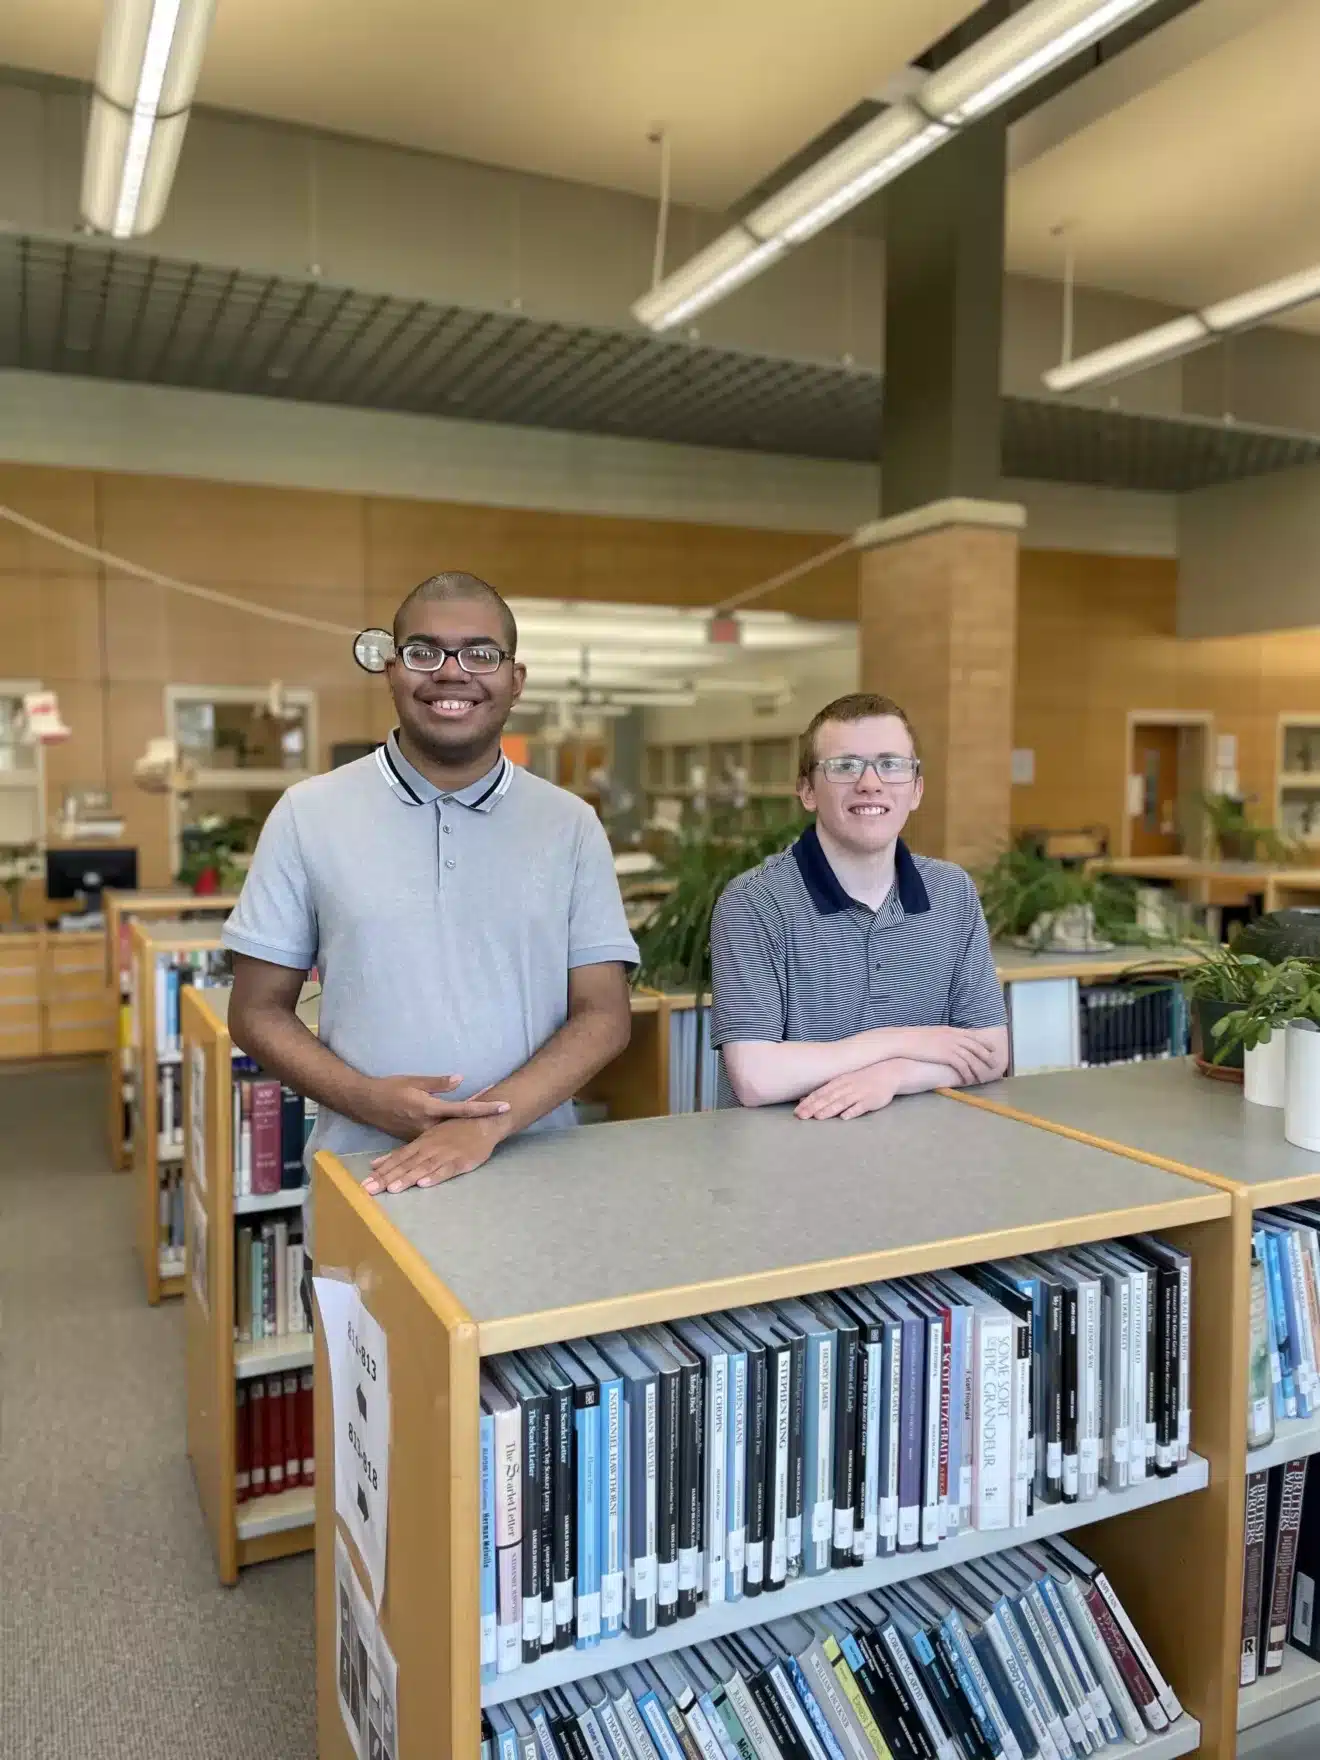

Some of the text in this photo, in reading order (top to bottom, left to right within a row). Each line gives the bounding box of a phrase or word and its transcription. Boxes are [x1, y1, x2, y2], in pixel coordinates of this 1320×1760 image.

[347, 1320, 377, 1381] 811-813
[821, 1348, 829, 1410] HENRY JAMES
[847, 1356, 855, 1381] Portrait
[892, 1338, 900, 1423] JOYCE CAROL OATES
[997, 1336, 1009, 1419] SOME SORT
[560, 1397, 568, 1463] The Scarlet Letter
[715, 1369, 723, 1433] KATE CHOPIN
[779, 1360, 788, 1449] STEPHEN KING
[846, 1395, 854, 1413] Lady
[939, 1352, 951, 1464] SCOTT FITZGERALD
[983, 1348, 996, 1469] EPIC GRANDEUR
[528, 1410, 536, 1477] The Scarlet Letter
[609, 1392, 618, 1516] NATHANIEL HAWTHORNE
[647, 1392, 655, 1480] HERMAN MELVILLE
[505, 1441, 517, 1537] The Scarlet Letter
[543, 1491, 551, 1512] LETTER
[1246, 1486, 1258, 1545] WRITERS
[1254, 1484, 1267, 1542] BRITISH
[1280, 1472, 1294, 1531] WRITERS
[1289, 1471, 1303, 1530] BRITISH
[1098, 1578, 1118, 1609] AMY TAN
[885, 1630, 907, 1665] CORMAC
[901, 1663, 926, 1702] McCARTHY
[1244, 1640, 1255, 1653] R
[626, 1707, 642, 1734] EDITH
[732, 1689, 764, 1745] RALPH ELLISON
[812, 1659, 833, 1692] WILLIAM
[828, 1692, 851, 1729] FAULKNER
[605, 1713, 624, 1748] THOMAS
